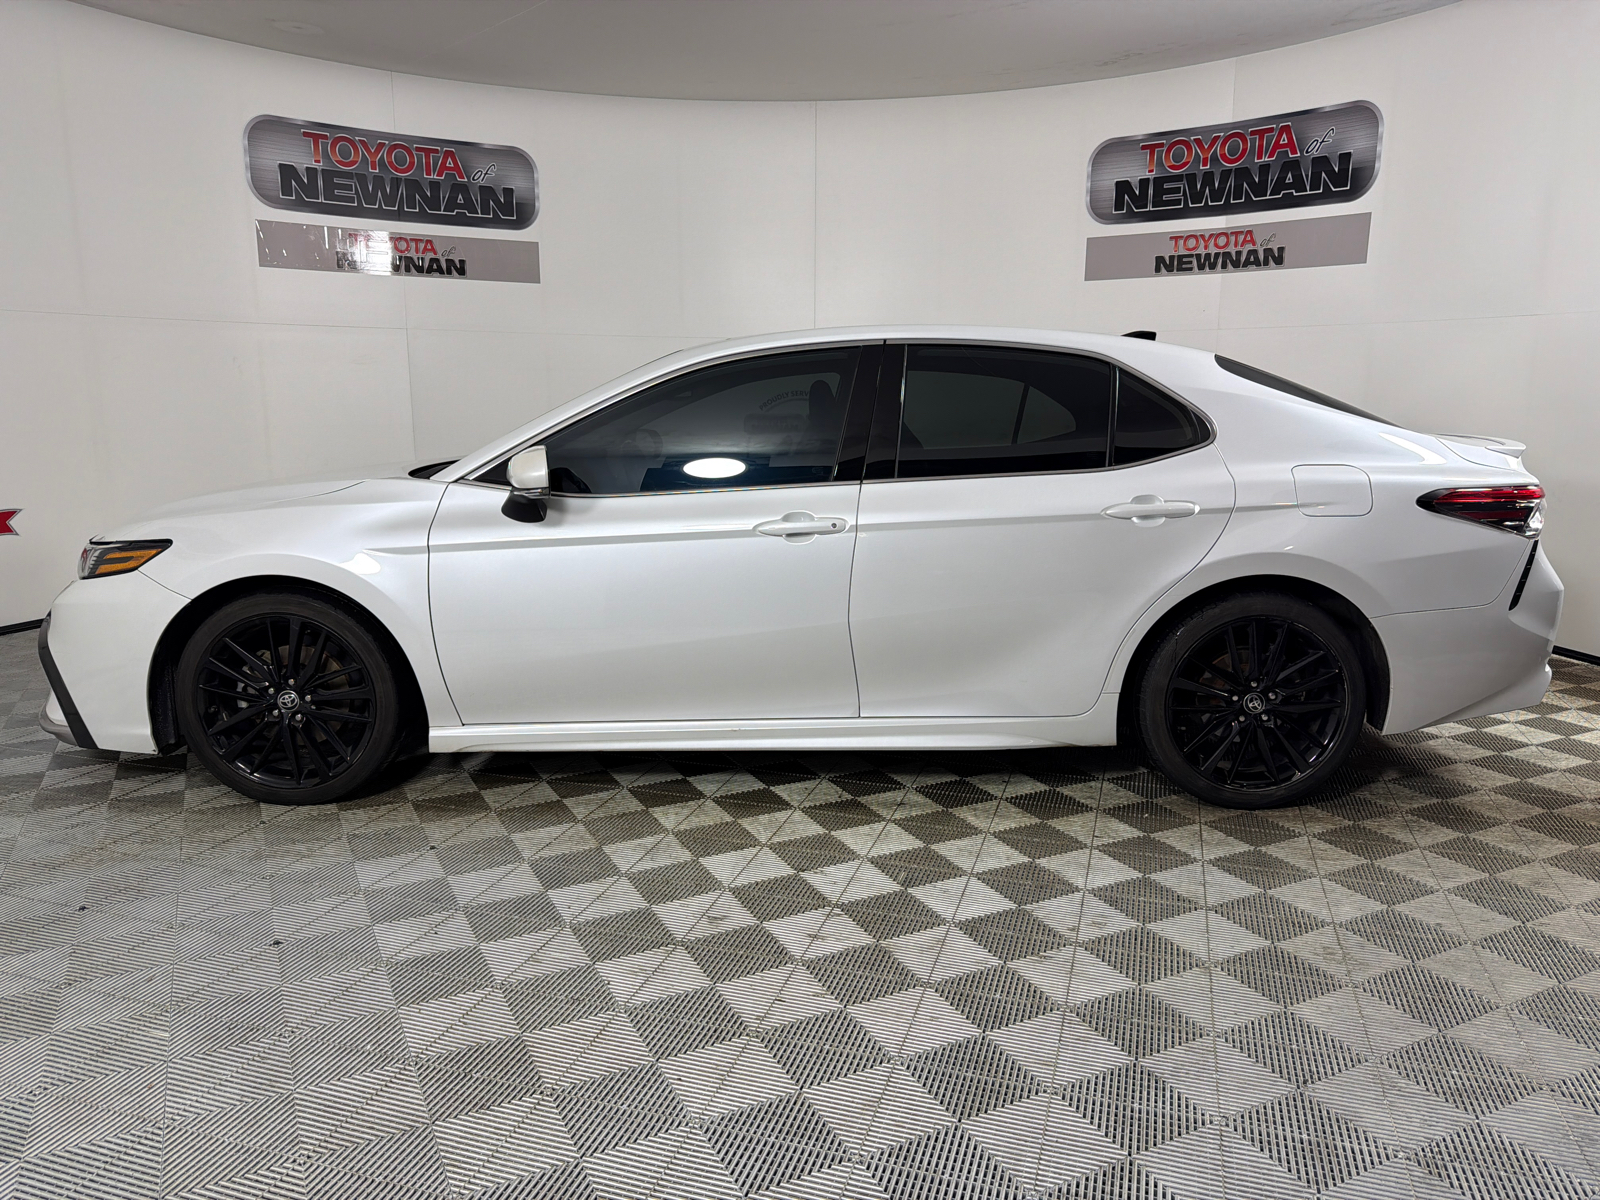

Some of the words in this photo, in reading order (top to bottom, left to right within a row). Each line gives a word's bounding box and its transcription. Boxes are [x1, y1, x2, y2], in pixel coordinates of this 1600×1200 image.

[301, 129, 468, 182] TOYOTA
[471, 163, 496, 183] of
[1140, 122, 1301, 175] TOYOTA
[1305, 127, 1336, 155] of
[278, 162, 517, 220] NEWNAN
[1112, 151, 1354, 213] NEWNAN
[349, 232, 438, 256] TOTA
[441, 246, 457, 258] of
[1169, 230, 1257, 253] TOYOTA
[1260, 233, 1276, 247] of
[336, 250, 466, 276] NNAN
[1154, 246, 1286, 274] NEWNAN
[759, 391, 790, 411] PROUDLY
